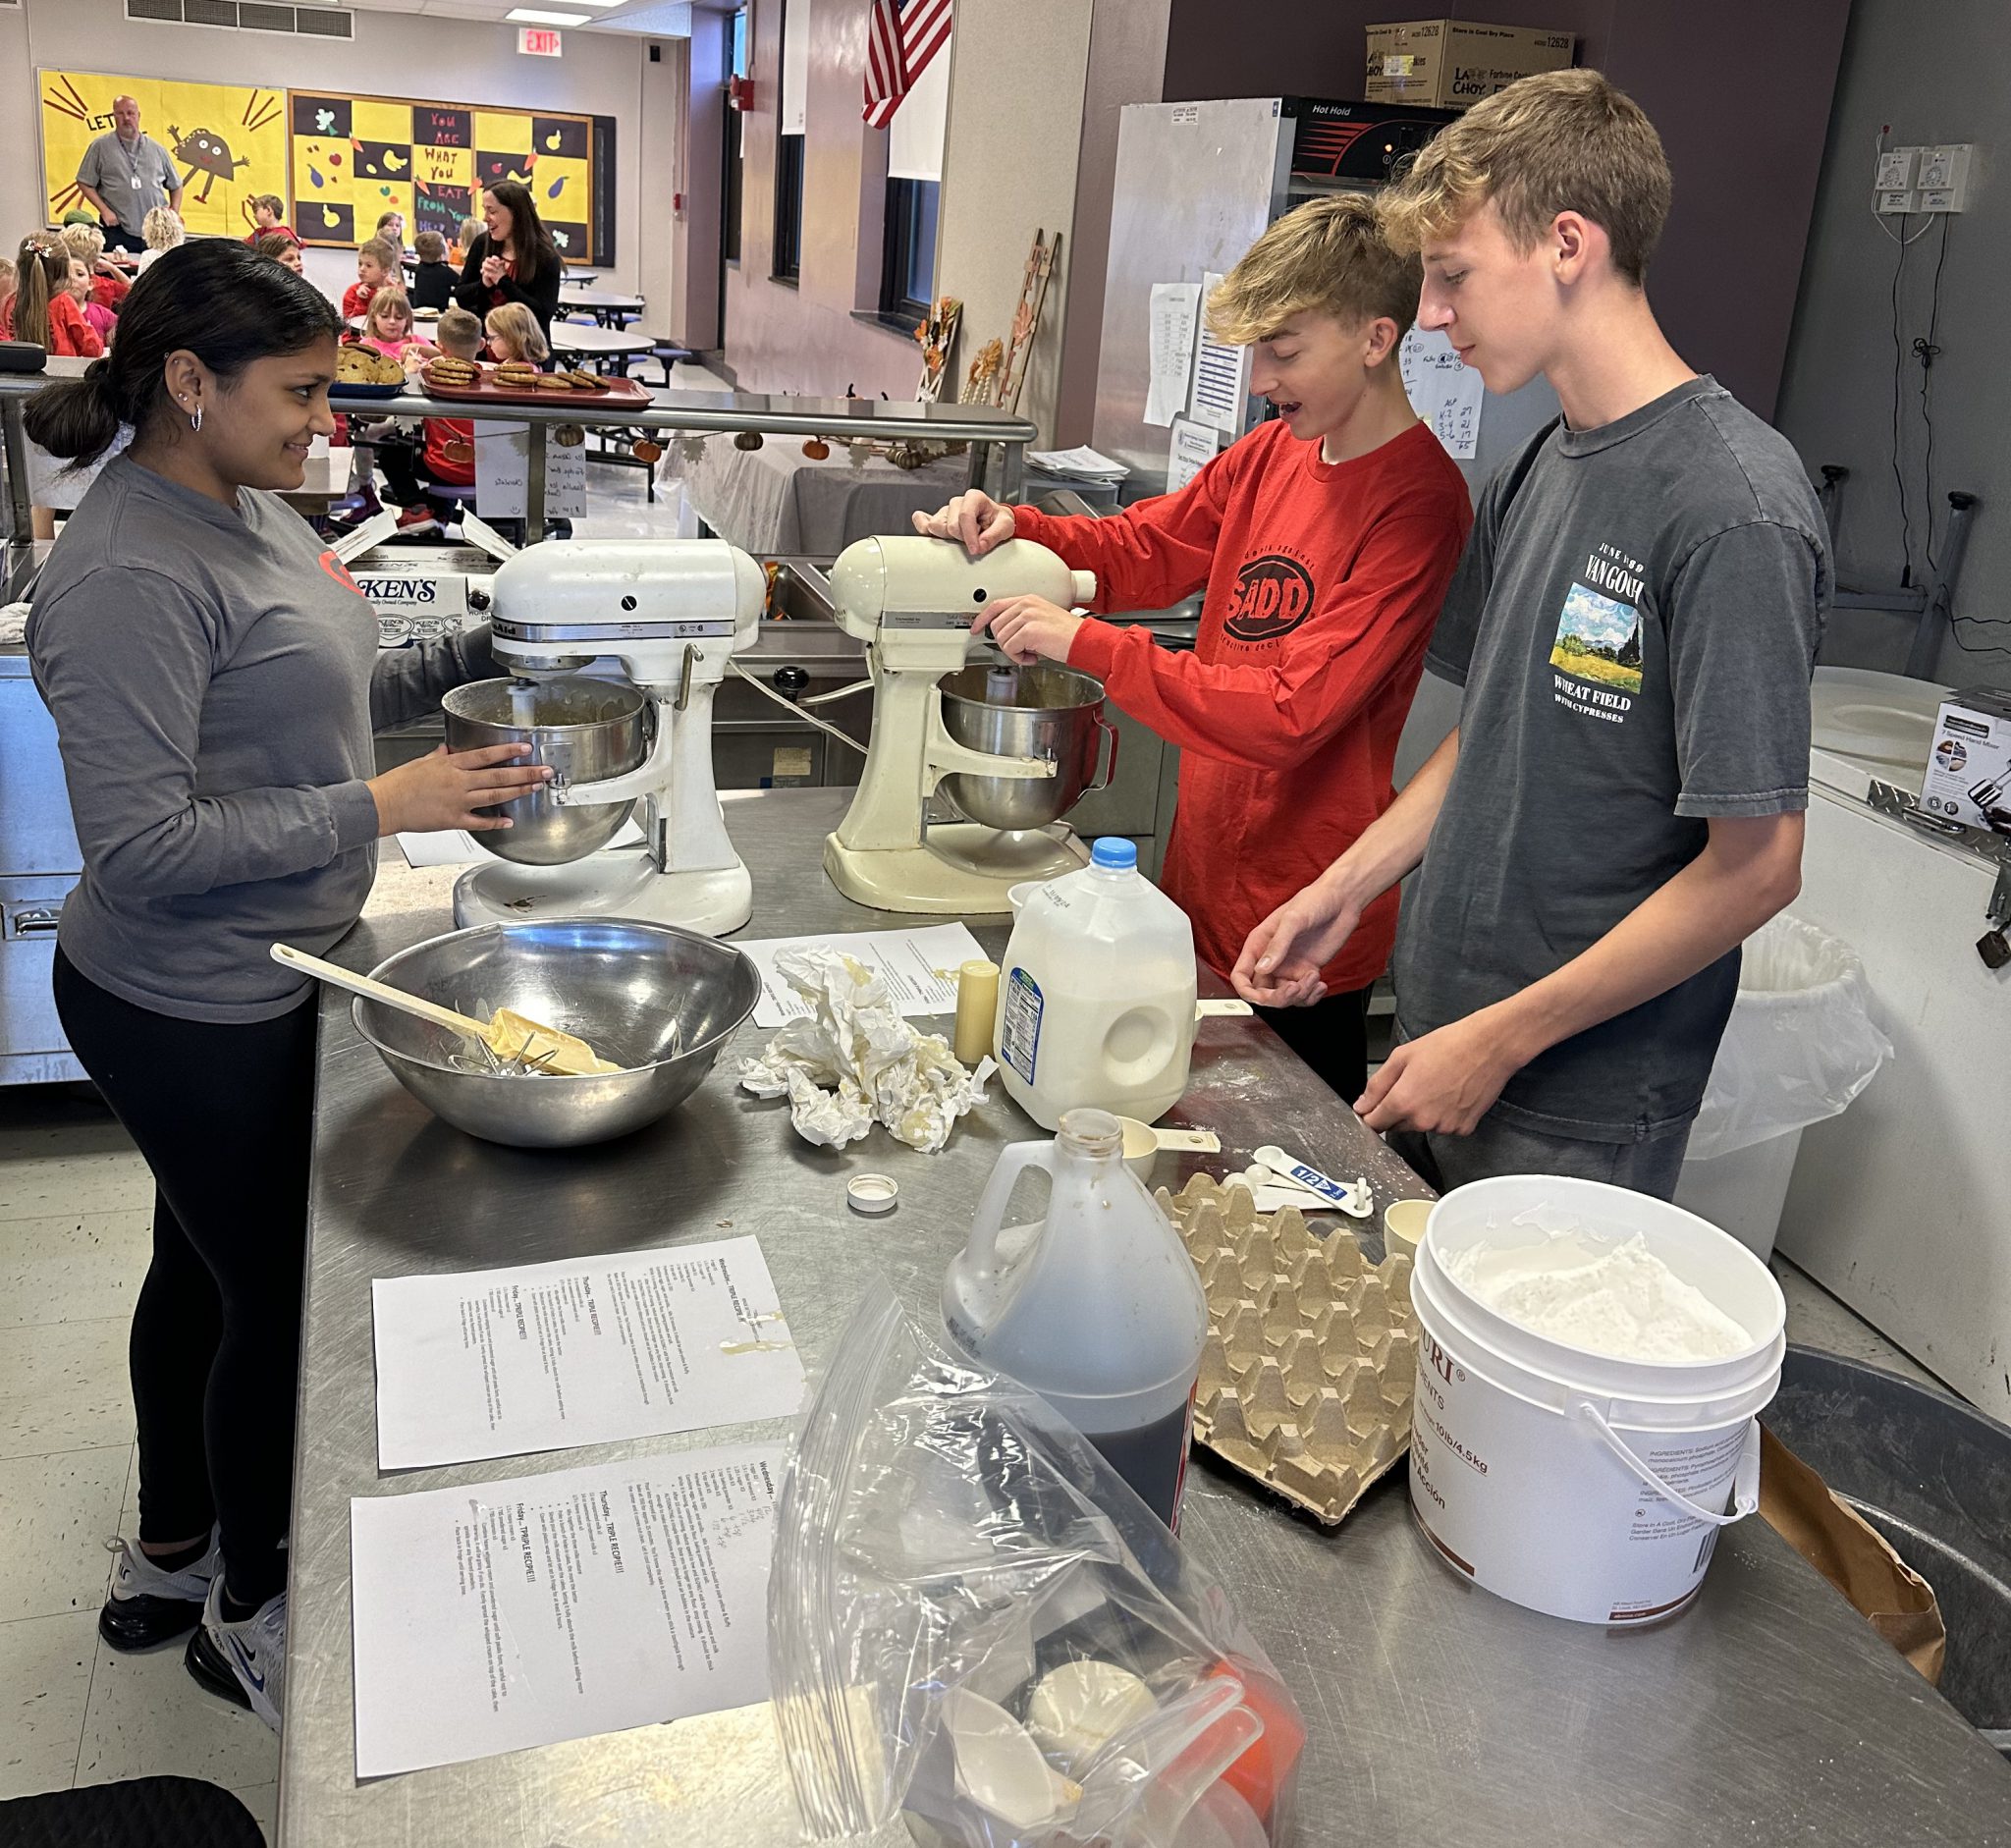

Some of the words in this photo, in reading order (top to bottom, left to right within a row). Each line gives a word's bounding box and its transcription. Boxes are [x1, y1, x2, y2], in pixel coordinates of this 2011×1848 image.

[526, 30, 555, 53] EXIT
[1455, 67, 1469, 80] LA
[1312, 104, 1329, 114] Hot
[1330, 106, 1351, 116] Hold
[431, 113, 456, 127] YOU
[435, 131, 460, 144] ARE
[425, 147, 458, 164] WHAT
[431, 166, 454, 181] YOU
[438, 186, 463, 199] EAT
[417, 196, 445, 214] FROM
[1599, 542, 1622, 560] JUNE
[356, 578, 437, 603] KEN'S
[1226, 577, 1309, 621] SADD
[1554, 675, 1591, 701] WHEAT
[1592, 690, 1631, 711] FIELD
[1572, 702, 1624, 724] CYPRESSES
[1297, 1169, 1320, 1185] 1/2
[519, 1525, 530, 1550] TPRIPLE
[606, 1521, 617, 1542] TRIPLE
[523, 1550, 535, 1583] RECIPIE!!!
[610, 1542, 624, 1573] RECIPIE!!!
